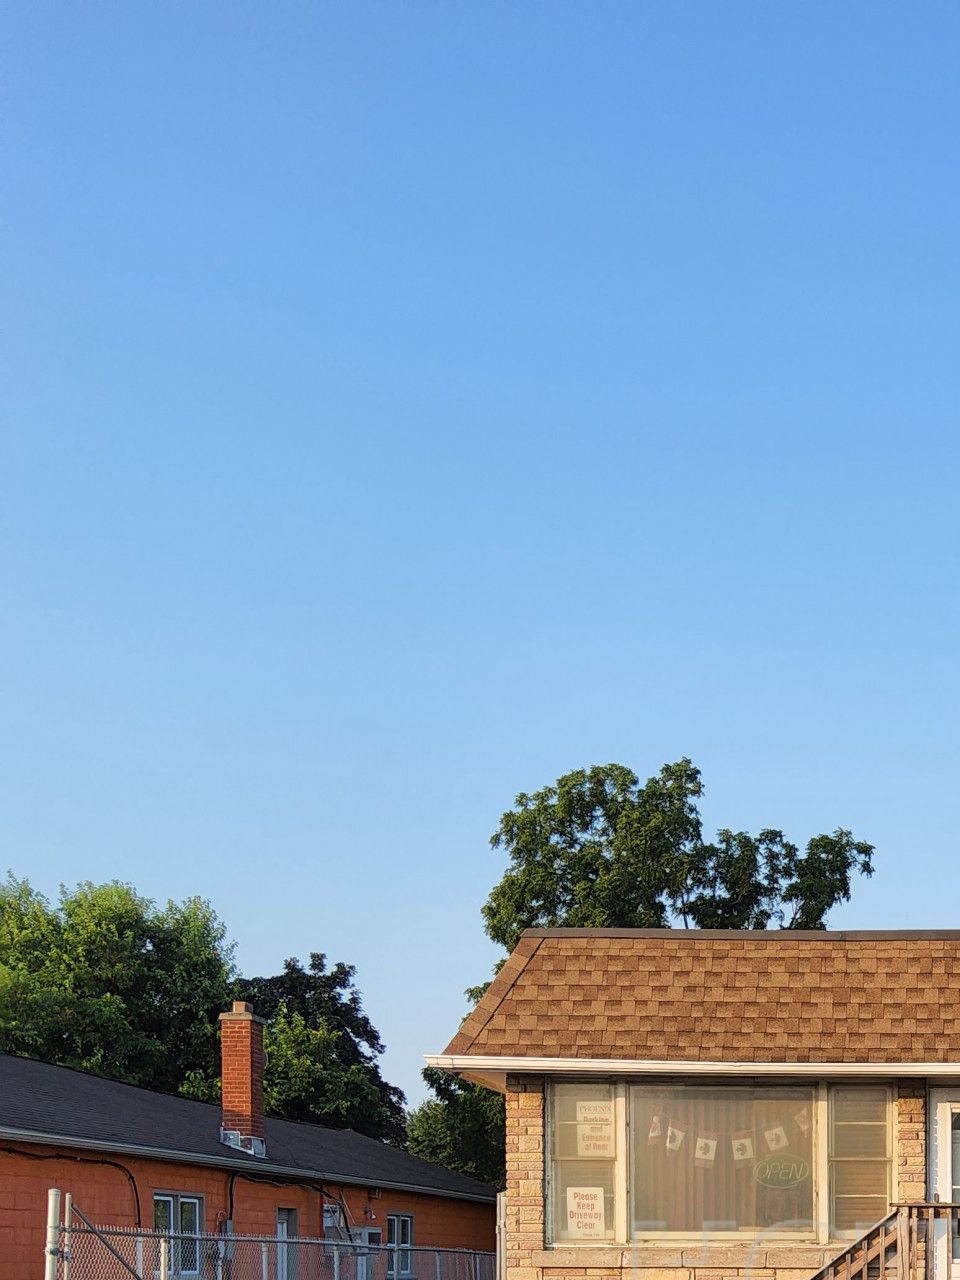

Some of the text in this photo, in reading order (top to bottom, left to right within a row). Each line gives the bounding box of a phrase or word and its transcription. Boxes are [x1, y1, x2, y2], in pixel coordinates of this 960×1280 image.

[757, 1160, 804, 1180] OPEN
[573, 1192, 598, 1201] Please
[576, 1202, 595, 1212] Keep
[569, 1211, 602, 1221] Driveway
[576, 1221, 596, 1229] Clear
